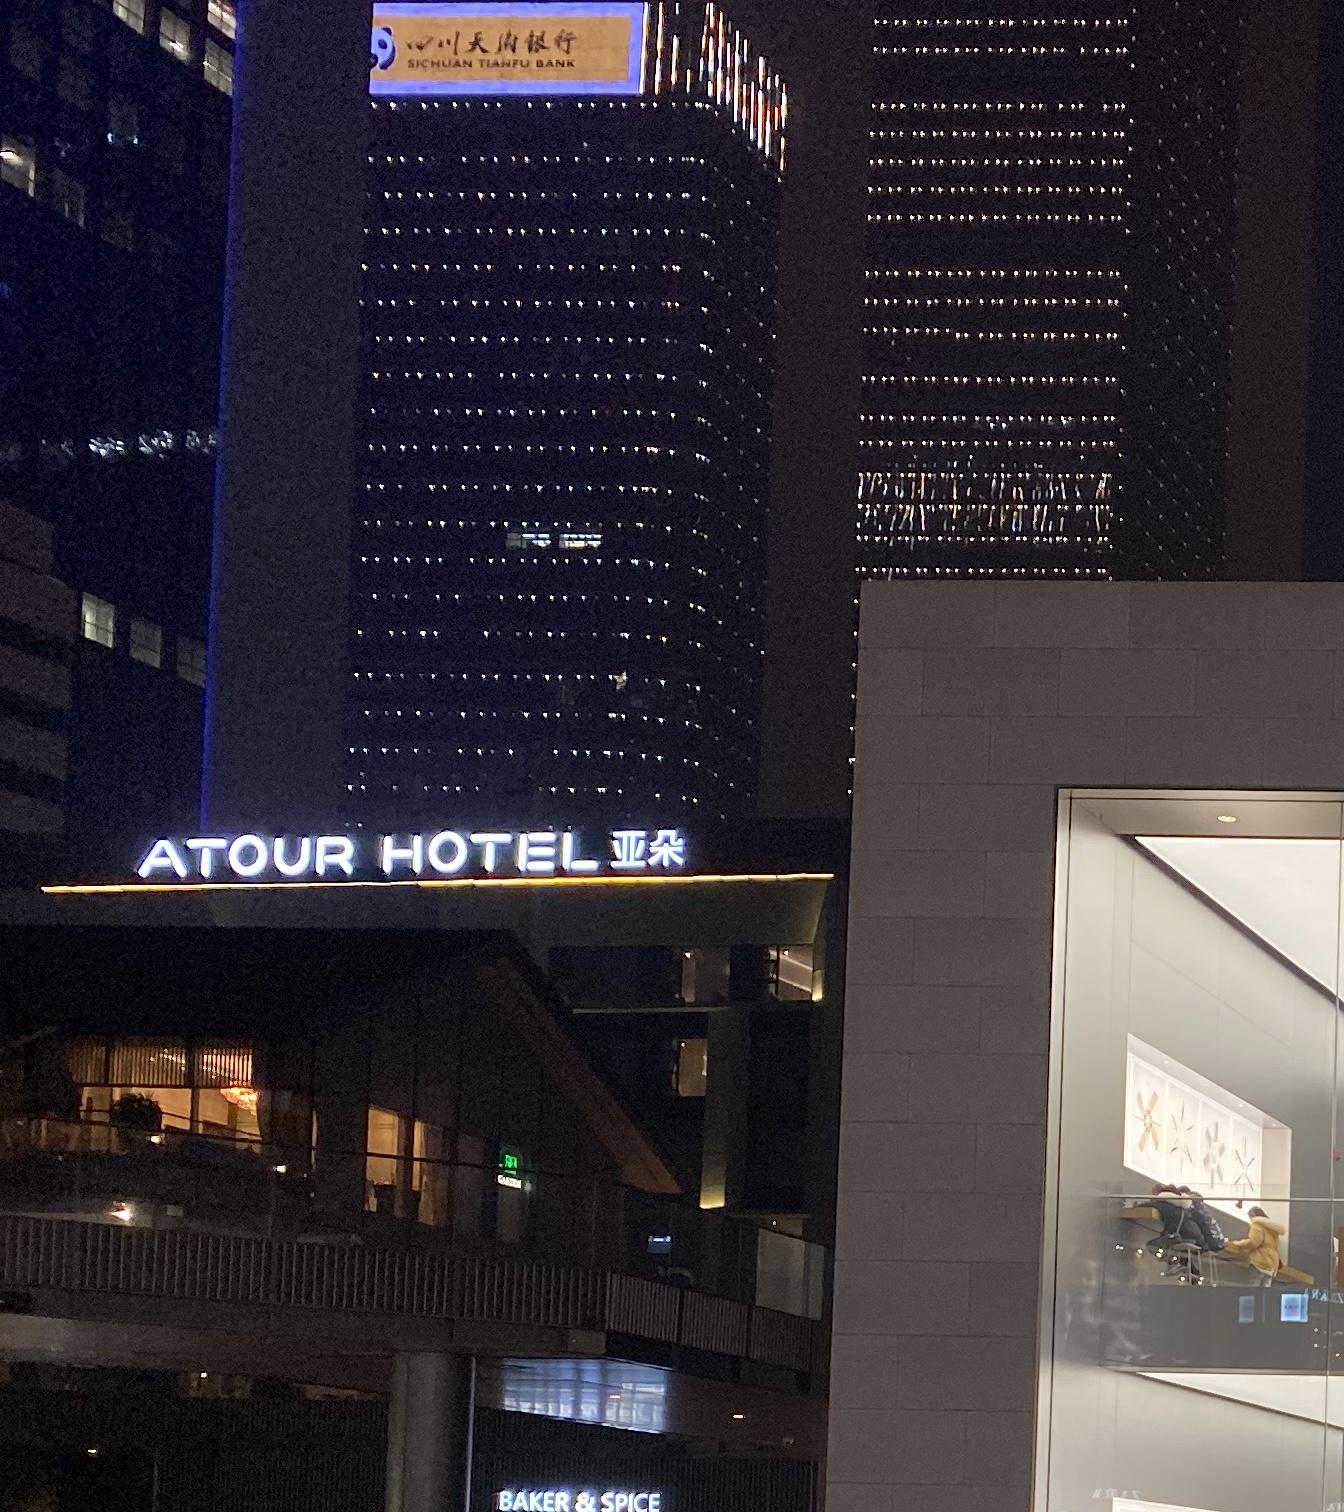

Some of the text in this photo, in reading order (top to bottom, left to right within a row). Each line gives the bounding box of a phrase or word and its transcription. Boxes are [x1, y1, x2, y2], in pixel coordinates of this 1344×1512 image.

[407, 58, 576, 69] SICHUAN TIANFU BANK
[136, 828, 687, 879] ATOUR HOTEL 亚朵
[498, 1489, 572, 1512] BAKER
